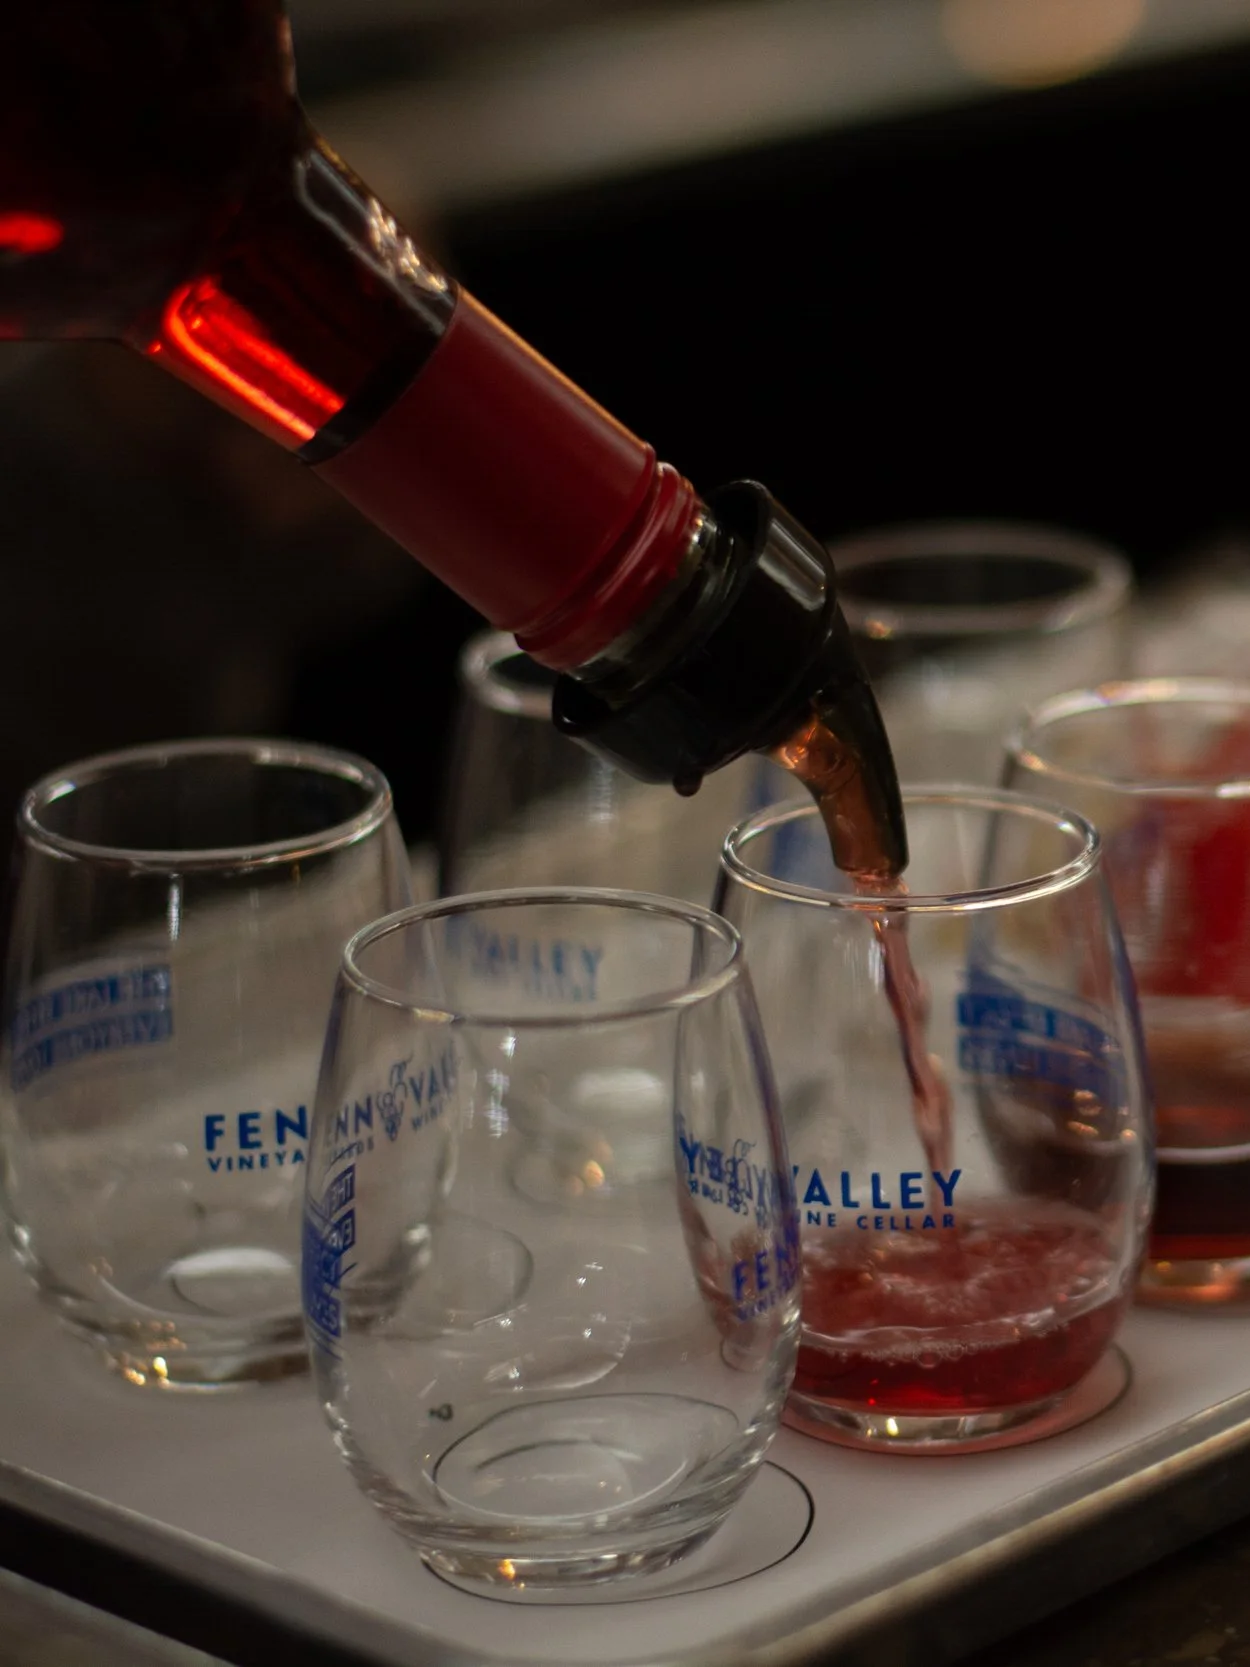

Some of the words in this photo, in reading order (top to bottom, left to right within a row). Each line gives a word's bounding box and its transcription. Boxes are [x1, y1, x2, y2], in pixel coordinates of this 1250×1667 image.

[791, 1165, 963, 1210] ALLEY
[797, 1209, 837, 1228] NE
[856, 1213, 956, 1231] CELLAR
